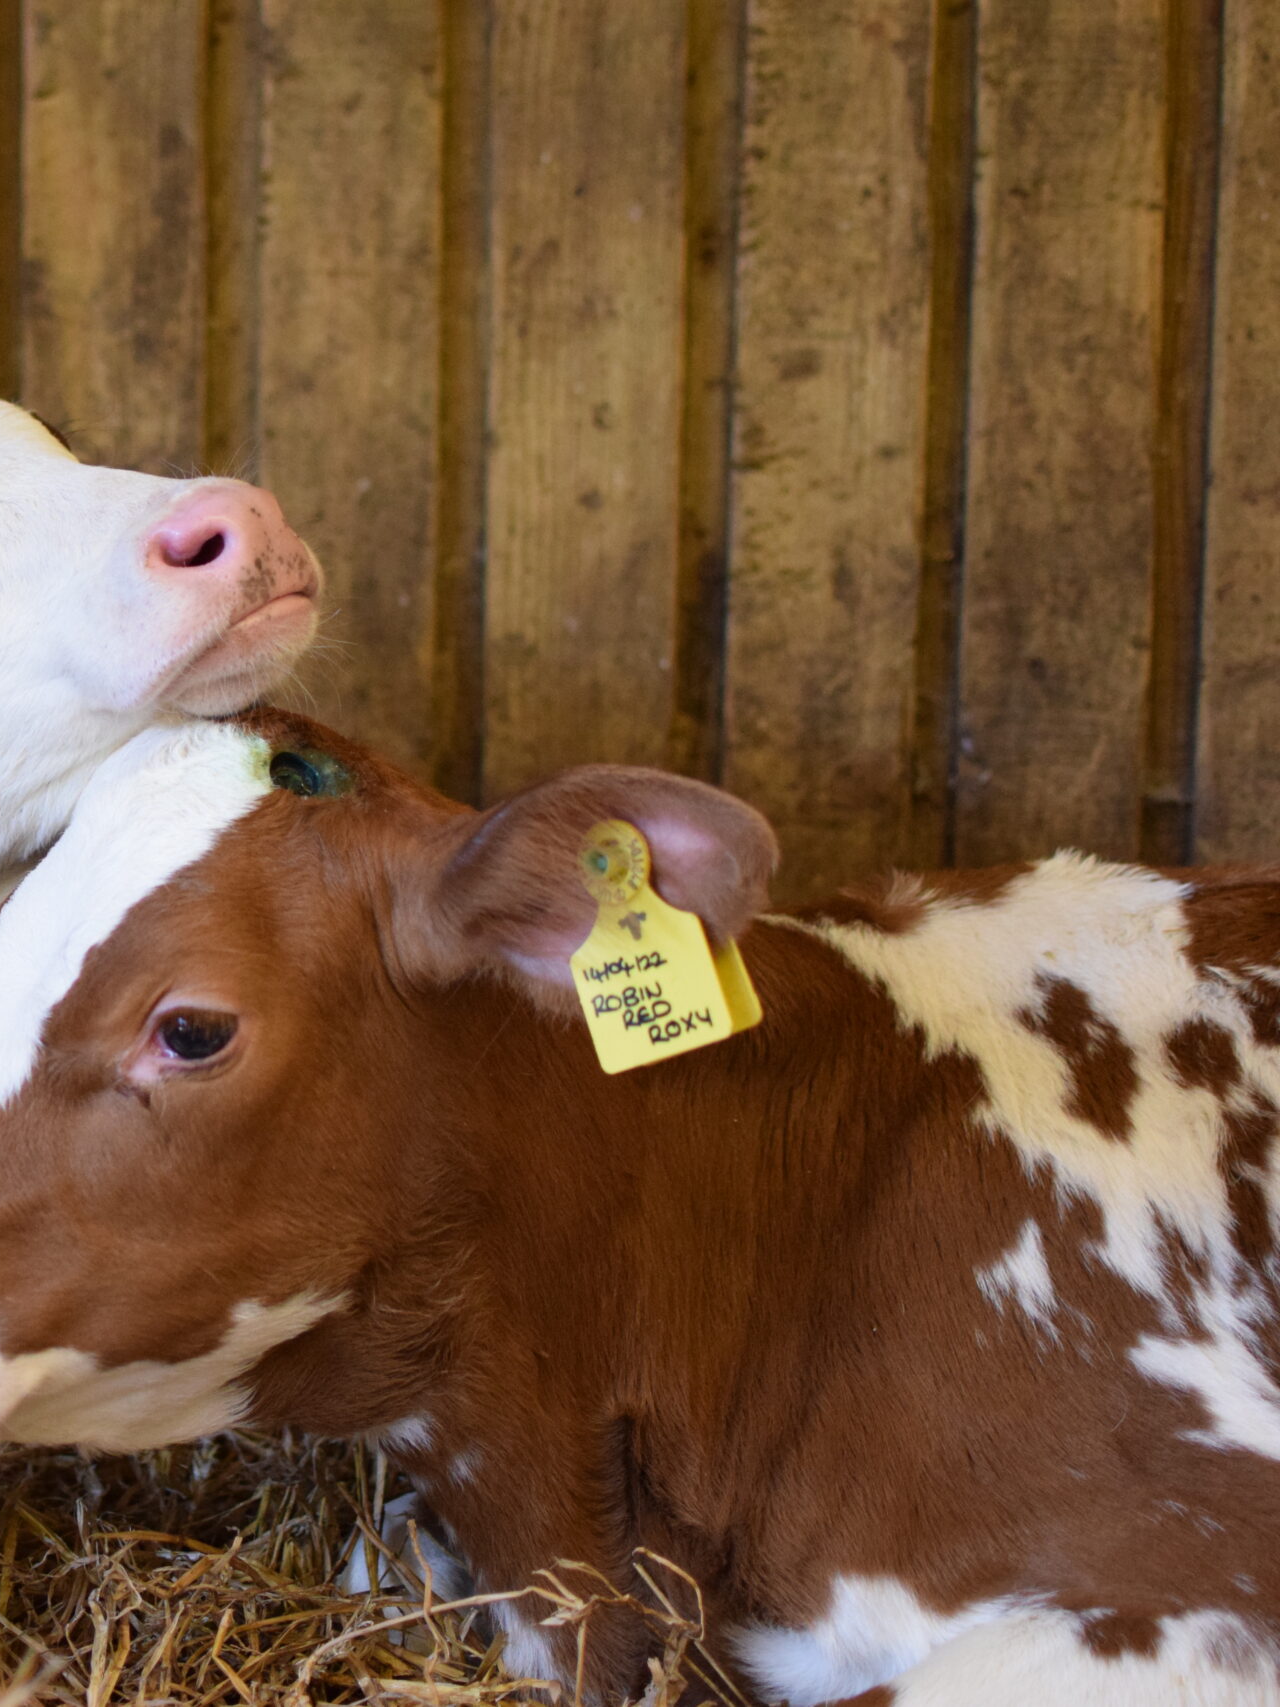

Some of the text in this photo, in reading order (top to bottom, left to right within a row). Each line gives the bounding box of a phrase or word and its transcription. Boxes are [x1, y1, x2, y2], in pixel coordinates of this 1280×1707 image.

[591, 981, 663, 1018] ROBIN
[622, 1000, 672, 1031] RED
[648, 1007, 714, 1044] ROXY
